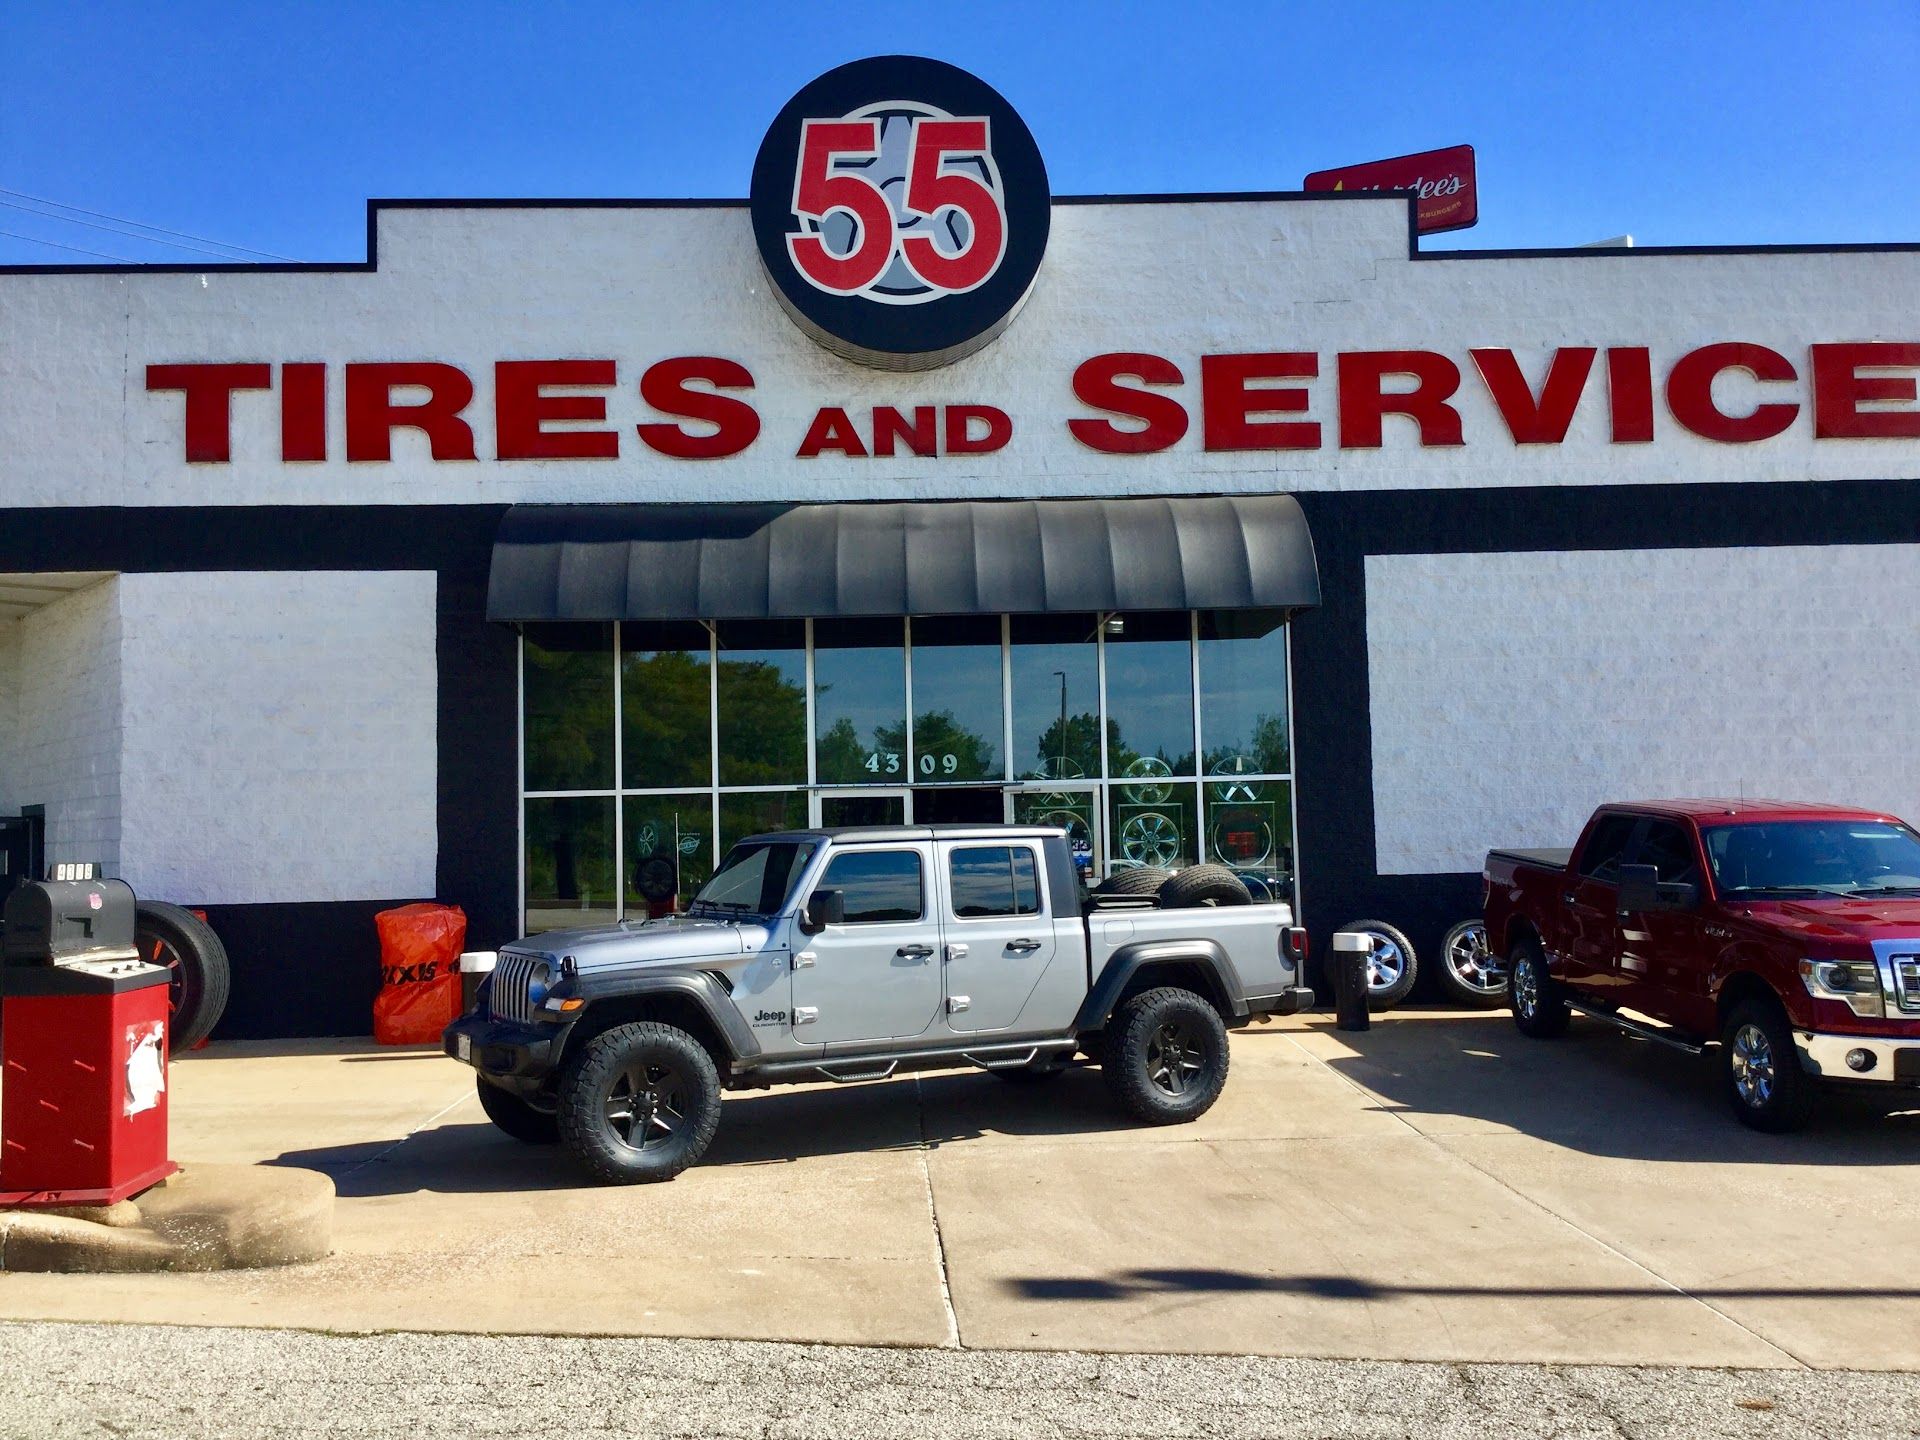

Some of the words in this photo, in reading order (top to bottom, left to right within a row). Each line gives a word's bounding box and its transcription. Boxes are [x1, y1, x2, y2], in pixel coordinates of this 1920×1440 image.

[785, 116, 1008, 296] 55
[146, 357, 761, 462] TIRES
[796, 405, 1013, 458] AND
[1067, 341, 1920, 454] SERVICE
[58, 864, 92, 880] 4309
[754, 1009, 786, 1022] Jeep
